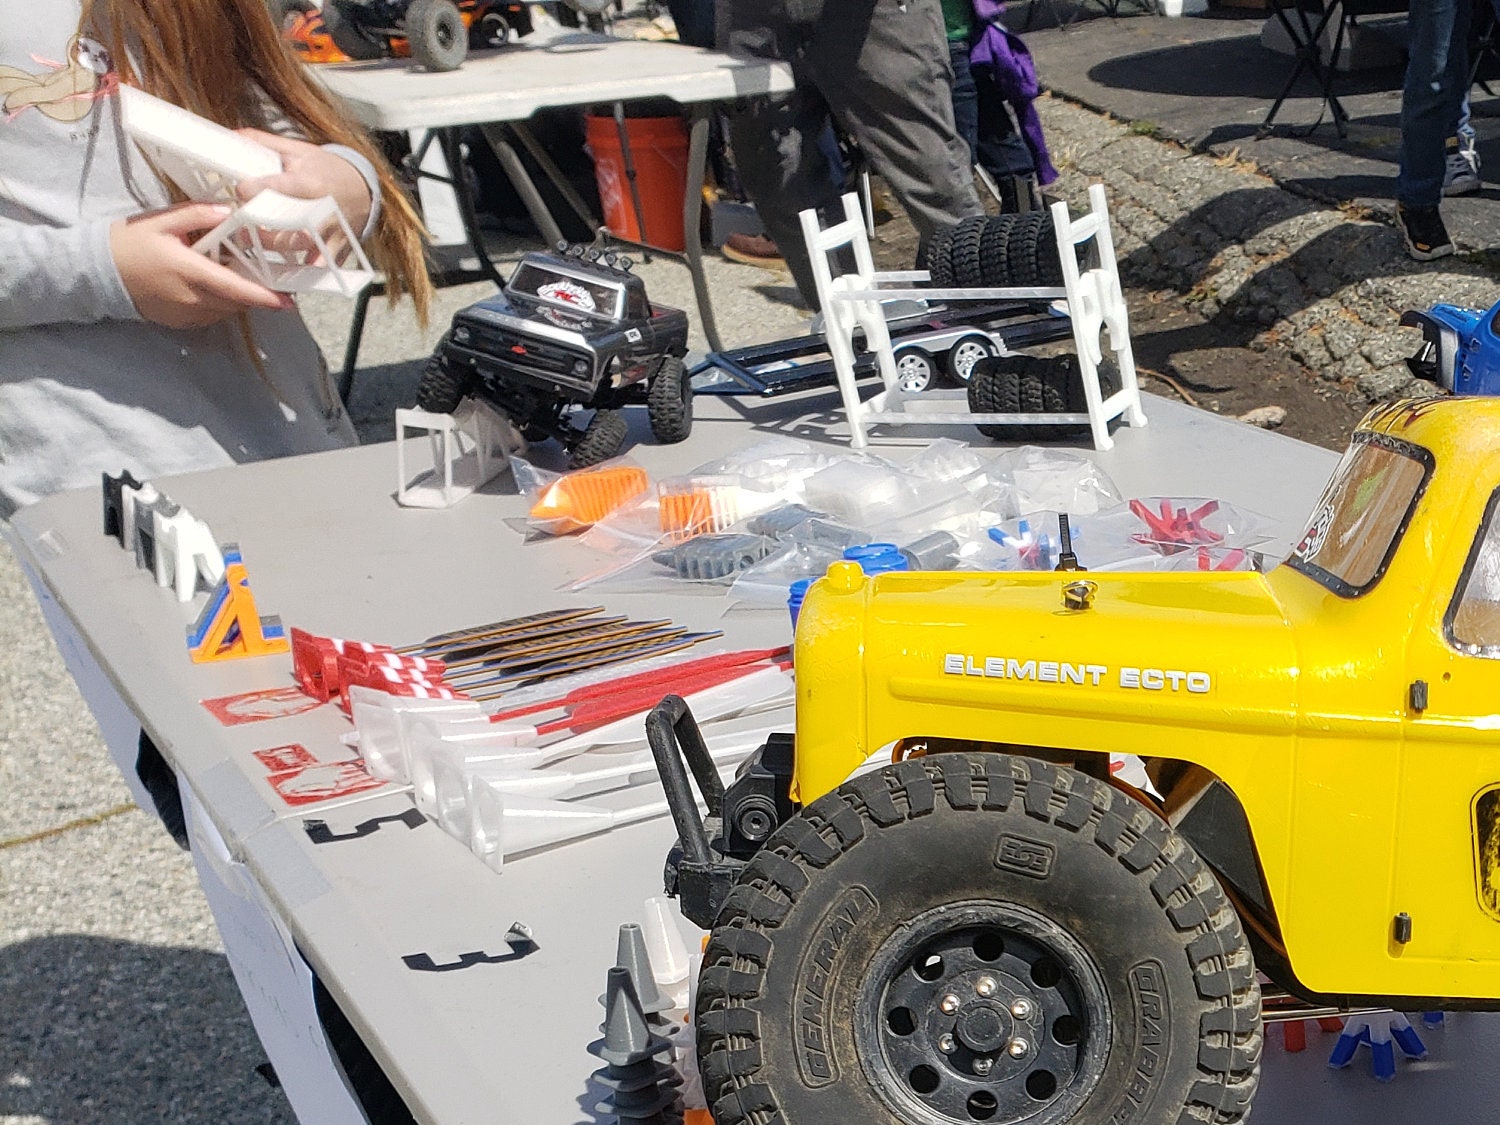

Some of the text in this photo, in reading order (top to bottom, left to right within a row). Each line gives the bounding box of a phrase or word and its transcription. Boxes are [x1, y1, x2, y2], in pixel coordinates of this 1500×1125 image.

[944, 653, 1211, 693] ELEMENT ECTO
[803, 894, 873, 1079] GENERAL
